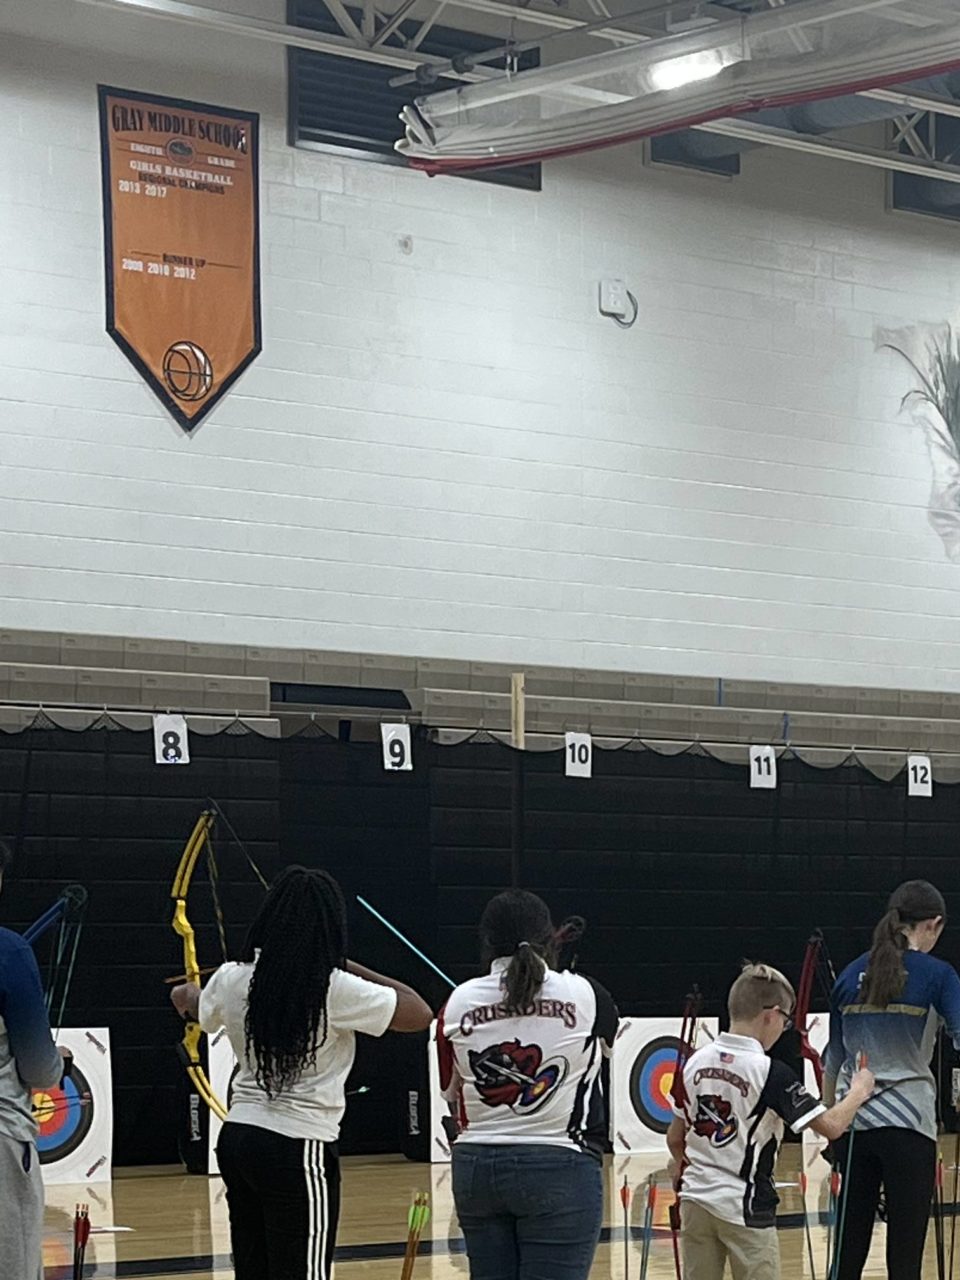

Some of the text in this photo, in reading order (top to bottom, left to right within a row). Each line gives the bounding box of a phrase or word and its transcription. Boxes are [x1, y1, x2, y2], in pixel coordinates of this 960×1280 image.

[112, 104, 144, 132] GRAY
[148, 111, 196, 138] MIDDLE
[129, 160, 233, 185] GIRLS BASKETBALL
[162, 731, 182, 763] 8
[390, 739, 405, 769] 9
[568, 742, 590, 765] 10
[754, 756, 772, 776] 11
[911, 765, 929, 784] 12
[460, 999, 577, 1036] CRUSADERS
